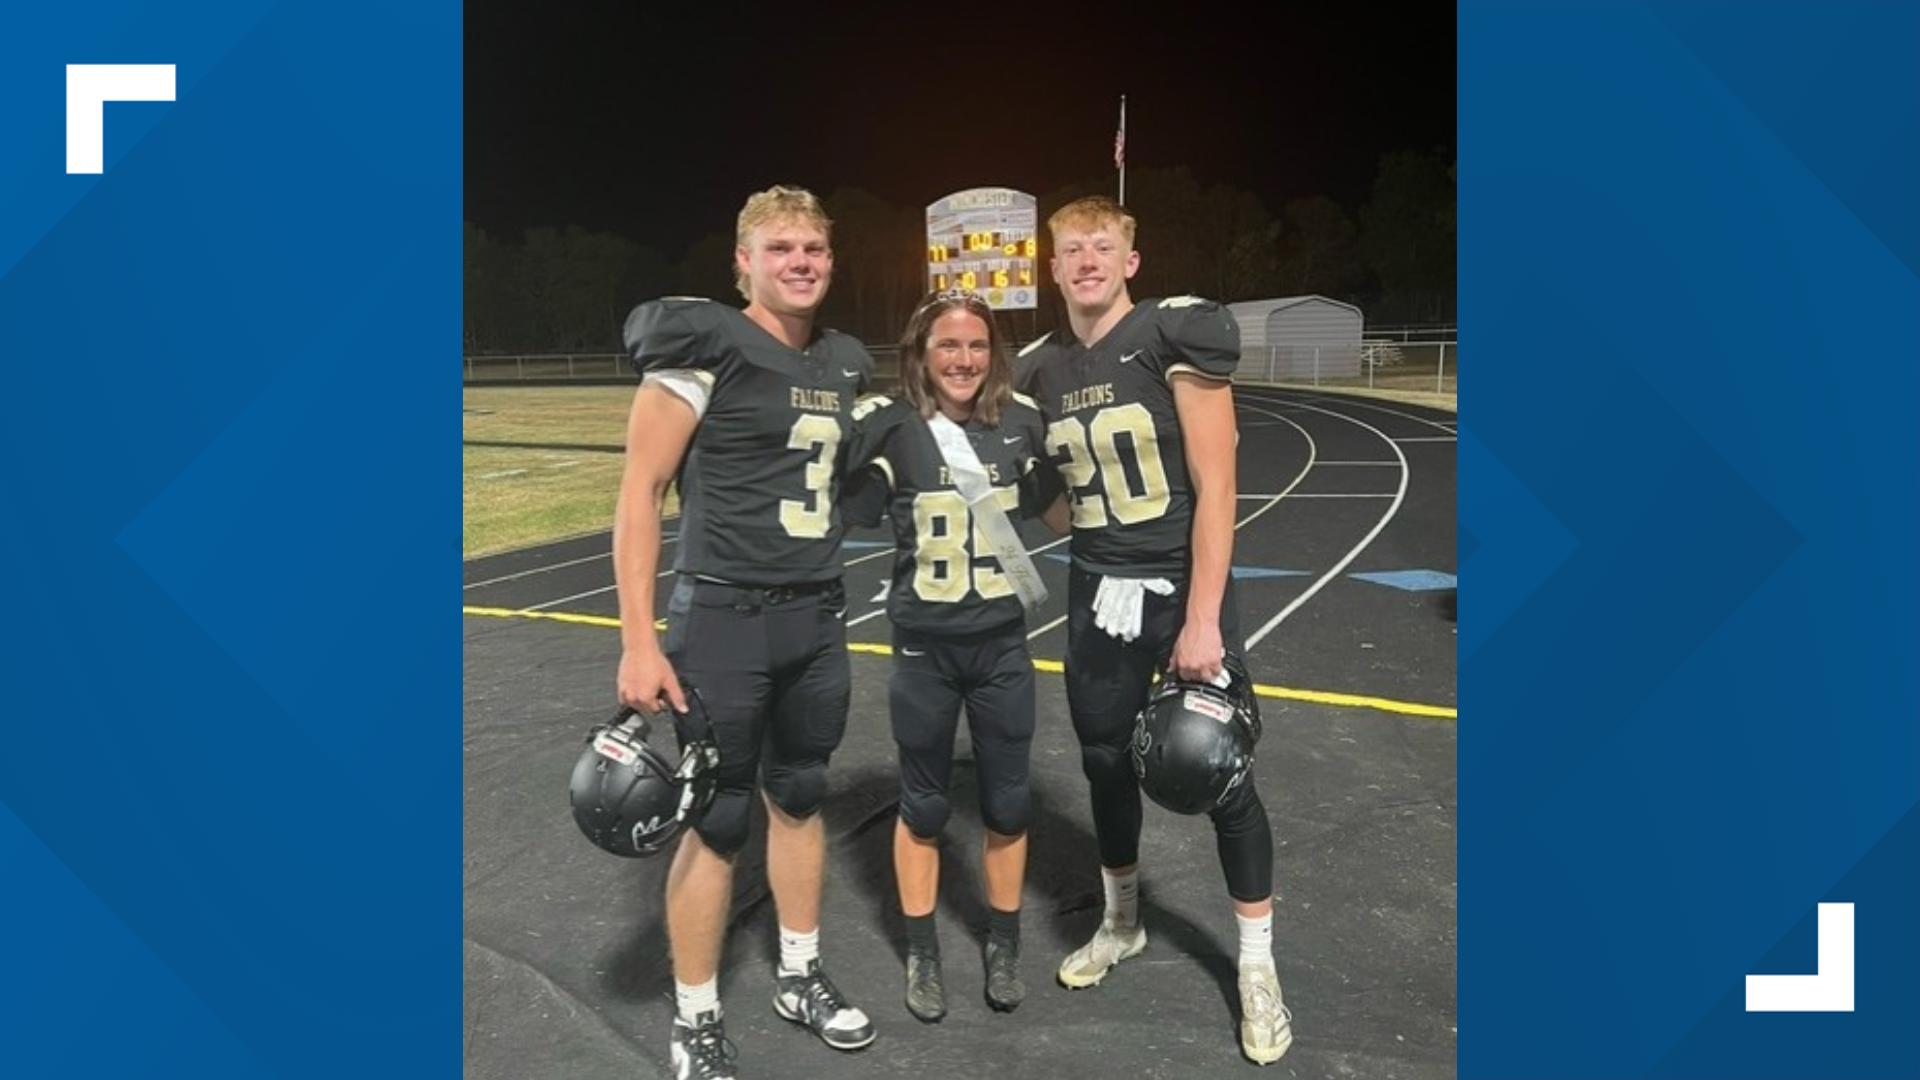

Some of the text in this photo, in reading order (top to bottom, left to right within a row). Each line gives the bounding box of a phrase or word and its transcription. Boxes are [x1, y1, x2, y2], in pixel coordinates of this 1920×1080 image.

[789, 386, 841, 413] FALCONS
[1061, 382, 1115, 414] FALCONS
[778, 413, 842, 539] 3
[1045, 402, 1171, 528] 20
[912, 484, 1019, 603] 85
